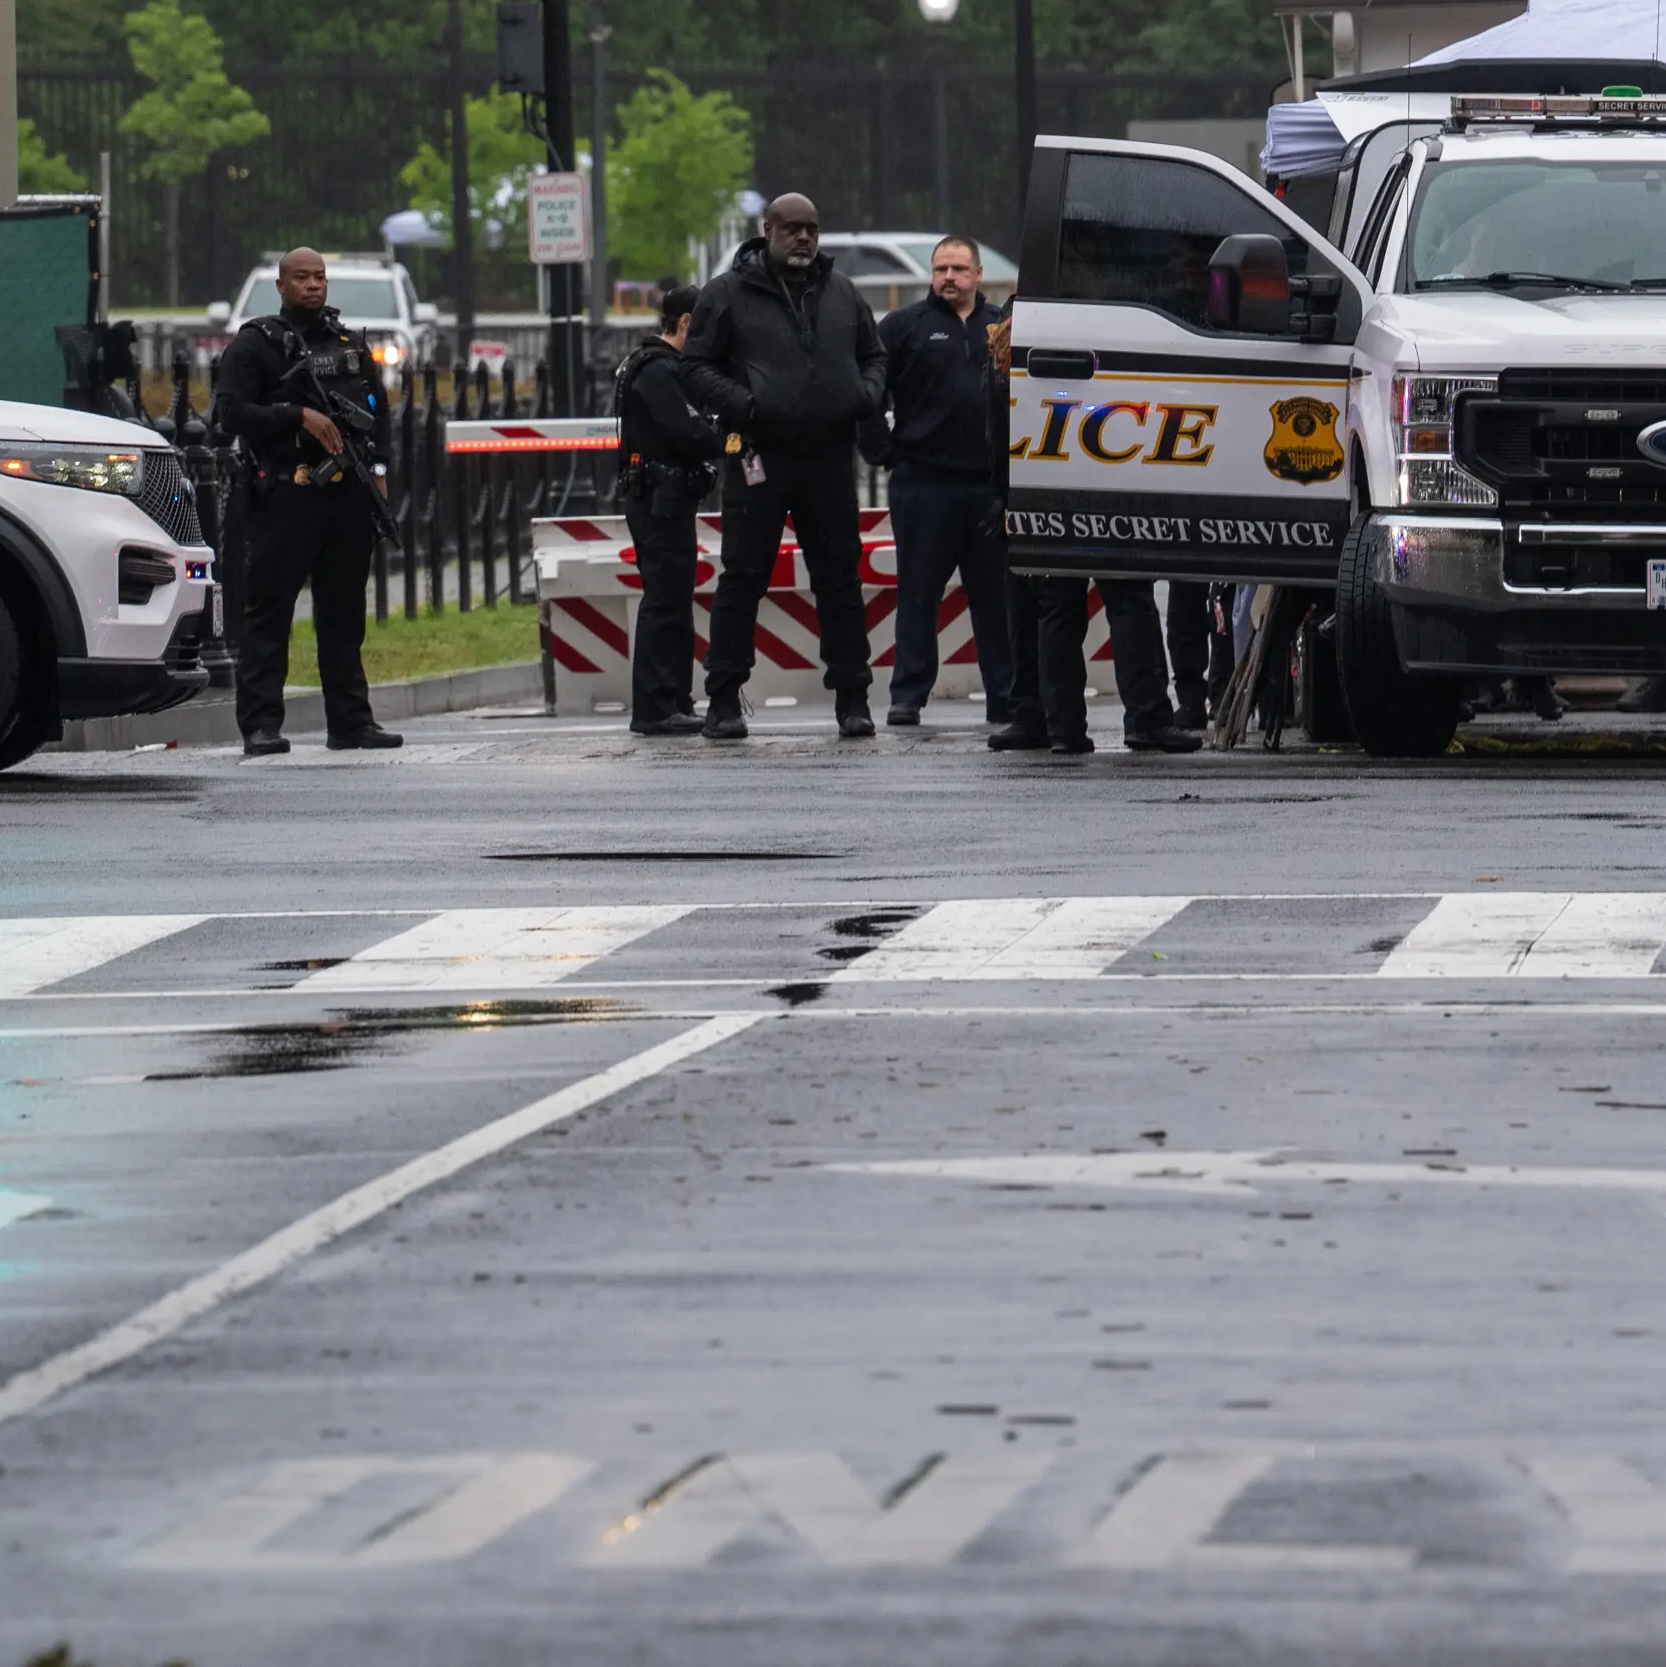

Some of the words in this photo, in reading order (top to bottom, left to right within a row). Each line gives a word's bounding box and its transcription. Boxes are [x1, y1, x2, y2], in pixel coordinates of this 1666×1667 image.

[1598, 101, 1635, 110] SECRET
[1072, 513, 1191, 542] SECRET
[1200, 518, 1334, 547] SERVICE
